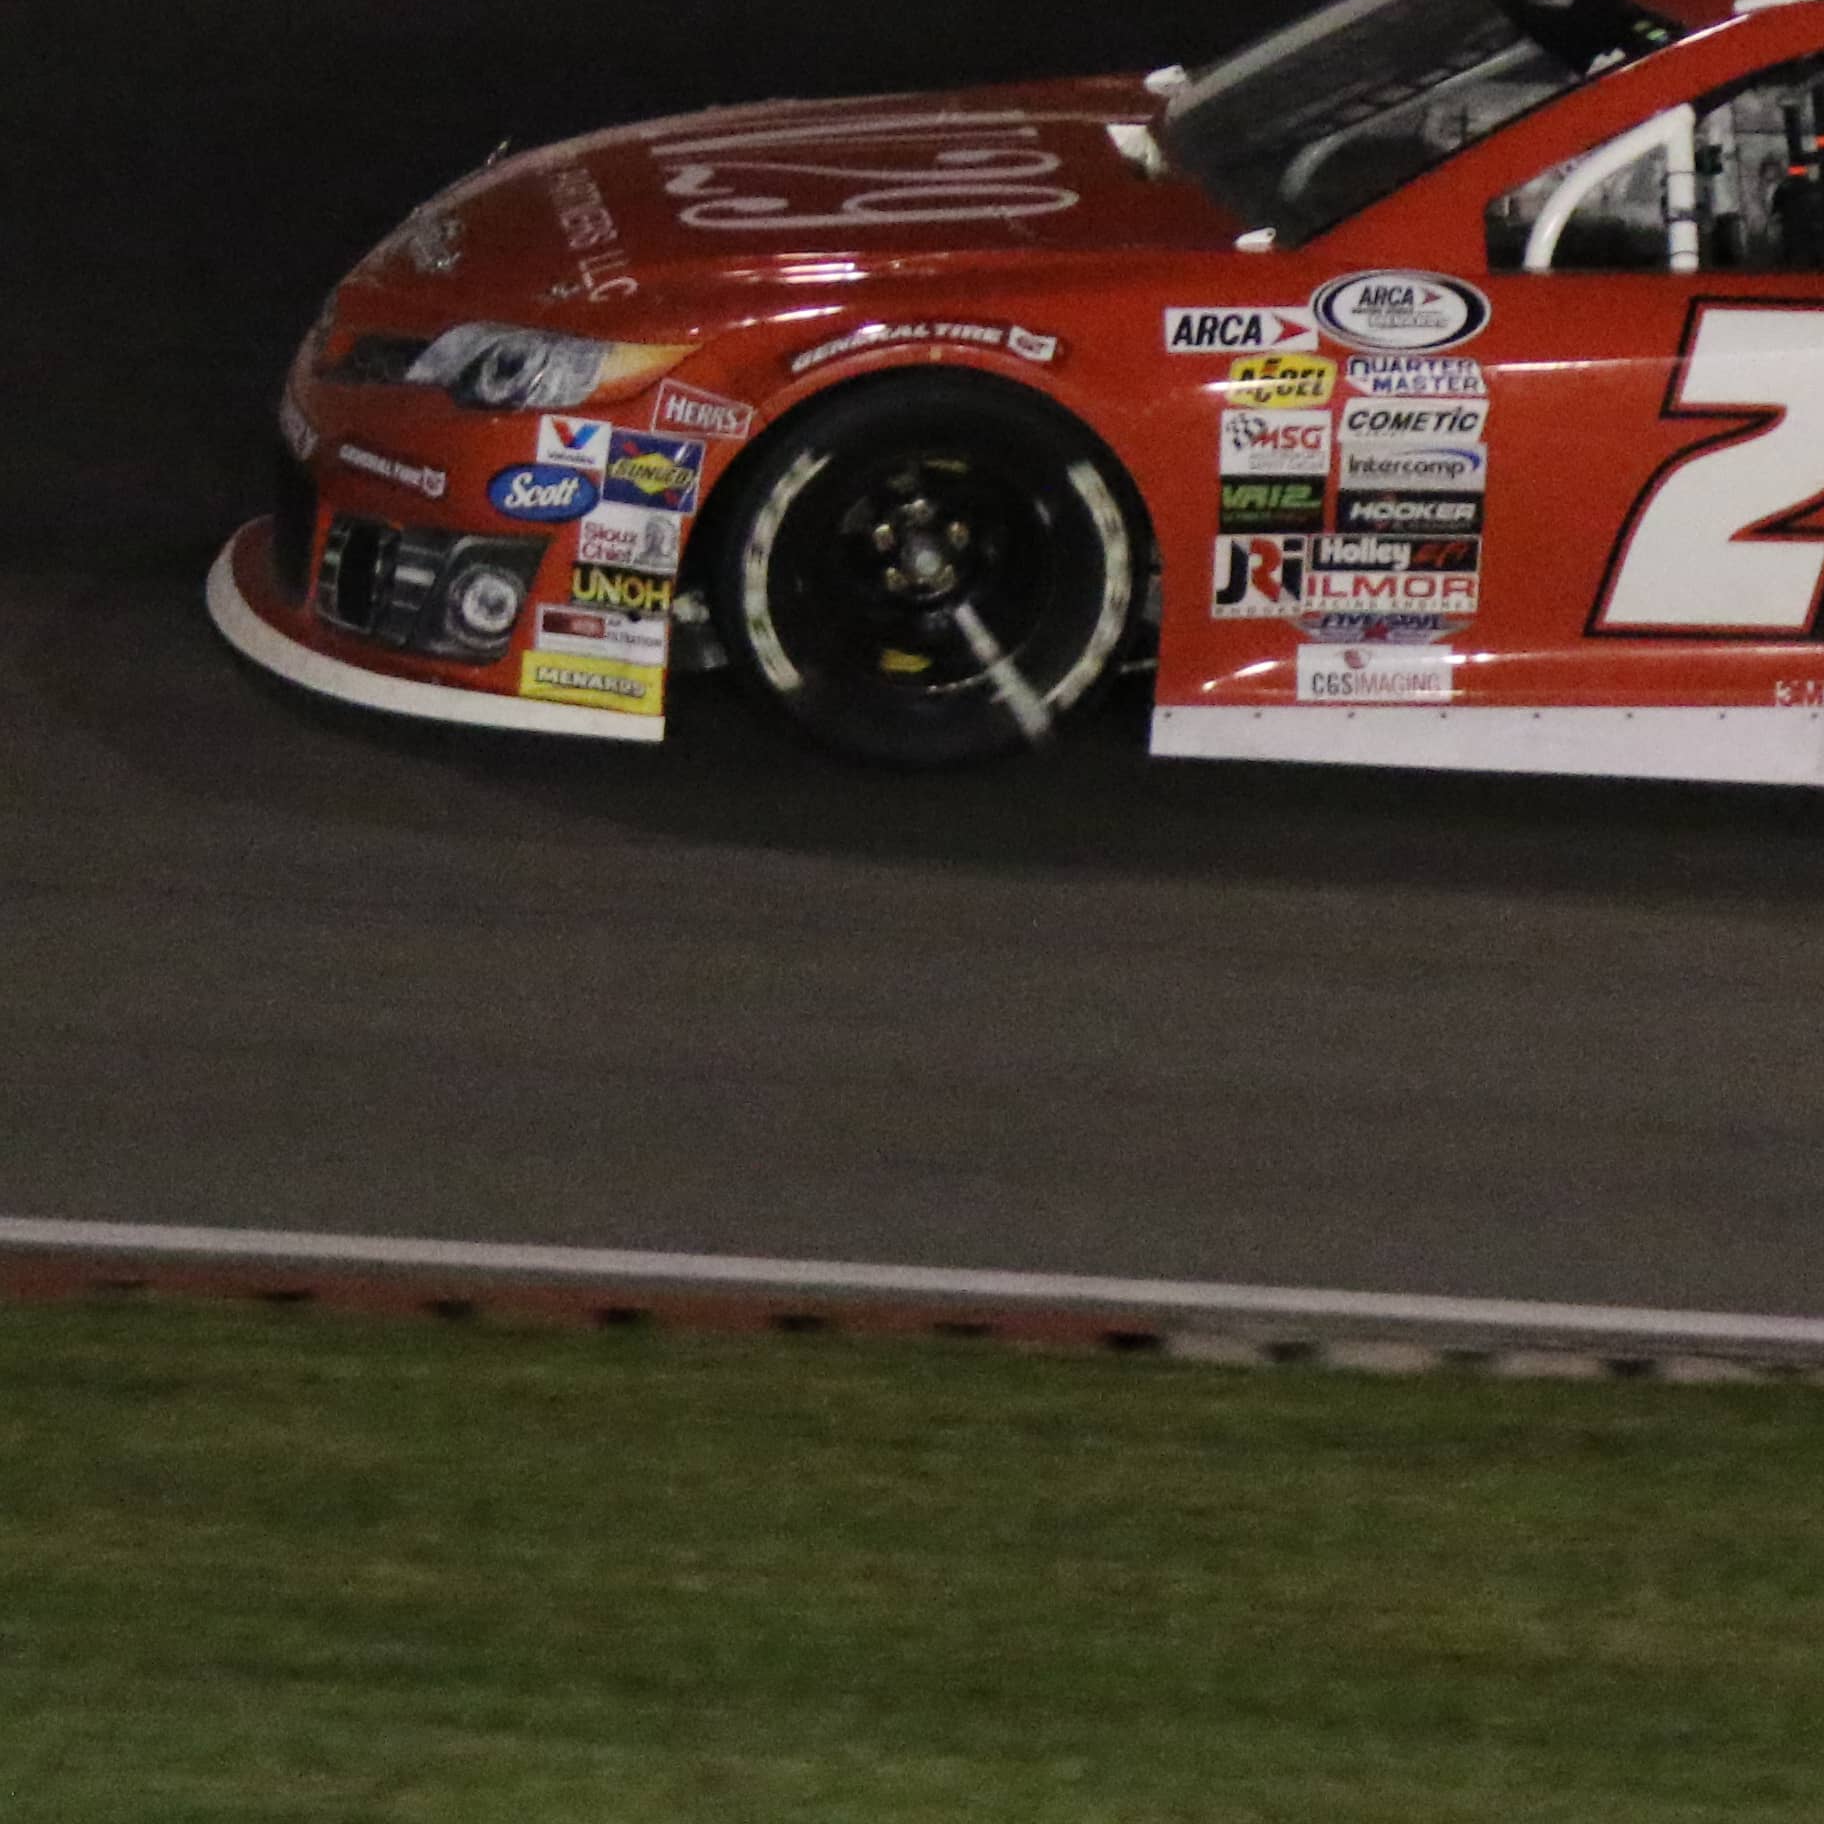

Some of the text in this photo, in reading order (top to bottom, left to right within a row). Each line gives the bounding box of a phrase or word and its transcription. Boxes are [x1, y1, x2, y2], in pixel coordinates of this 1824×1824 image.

[1358, 285, 1414, 306] ARCA
[1172, 314, 1263, 347] ARCA
[1350, 356, 1476, 375] QUARTER
[1372, 377, 1483, 394] MASTER
[1250, 425, 1322, 450] MSG
[1348, 454, 1465, 479] Intercomp
[503, 471, 581, 509] Scott
[1350, 501, 1477, 520] HOOKER
[1320, 539, 1413, 571] Holley
[573, 567, 672, 612] UNOH
[1305, 577, 1476, 598] ILMOR
